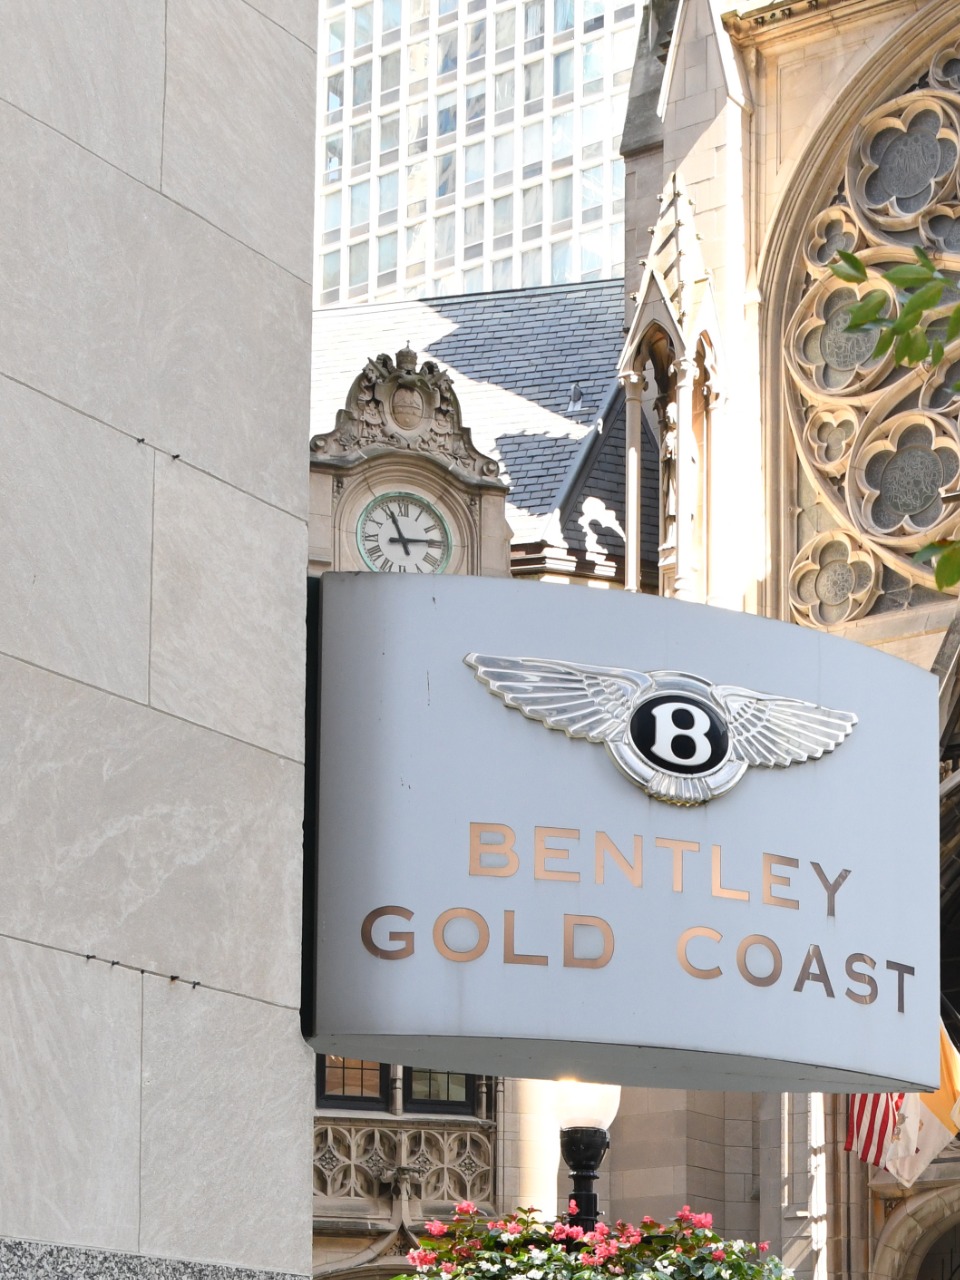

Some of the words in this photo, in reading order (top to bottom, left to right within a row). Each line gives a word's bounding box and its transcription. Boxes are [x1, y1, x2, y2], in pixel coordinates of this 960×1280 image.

[650, 701, 713, 767] B
[469, 821, 852, 917] BENTLEY
[360, 905, 615, 970] GOLD
[676, 926, 916, 1014] COAST
